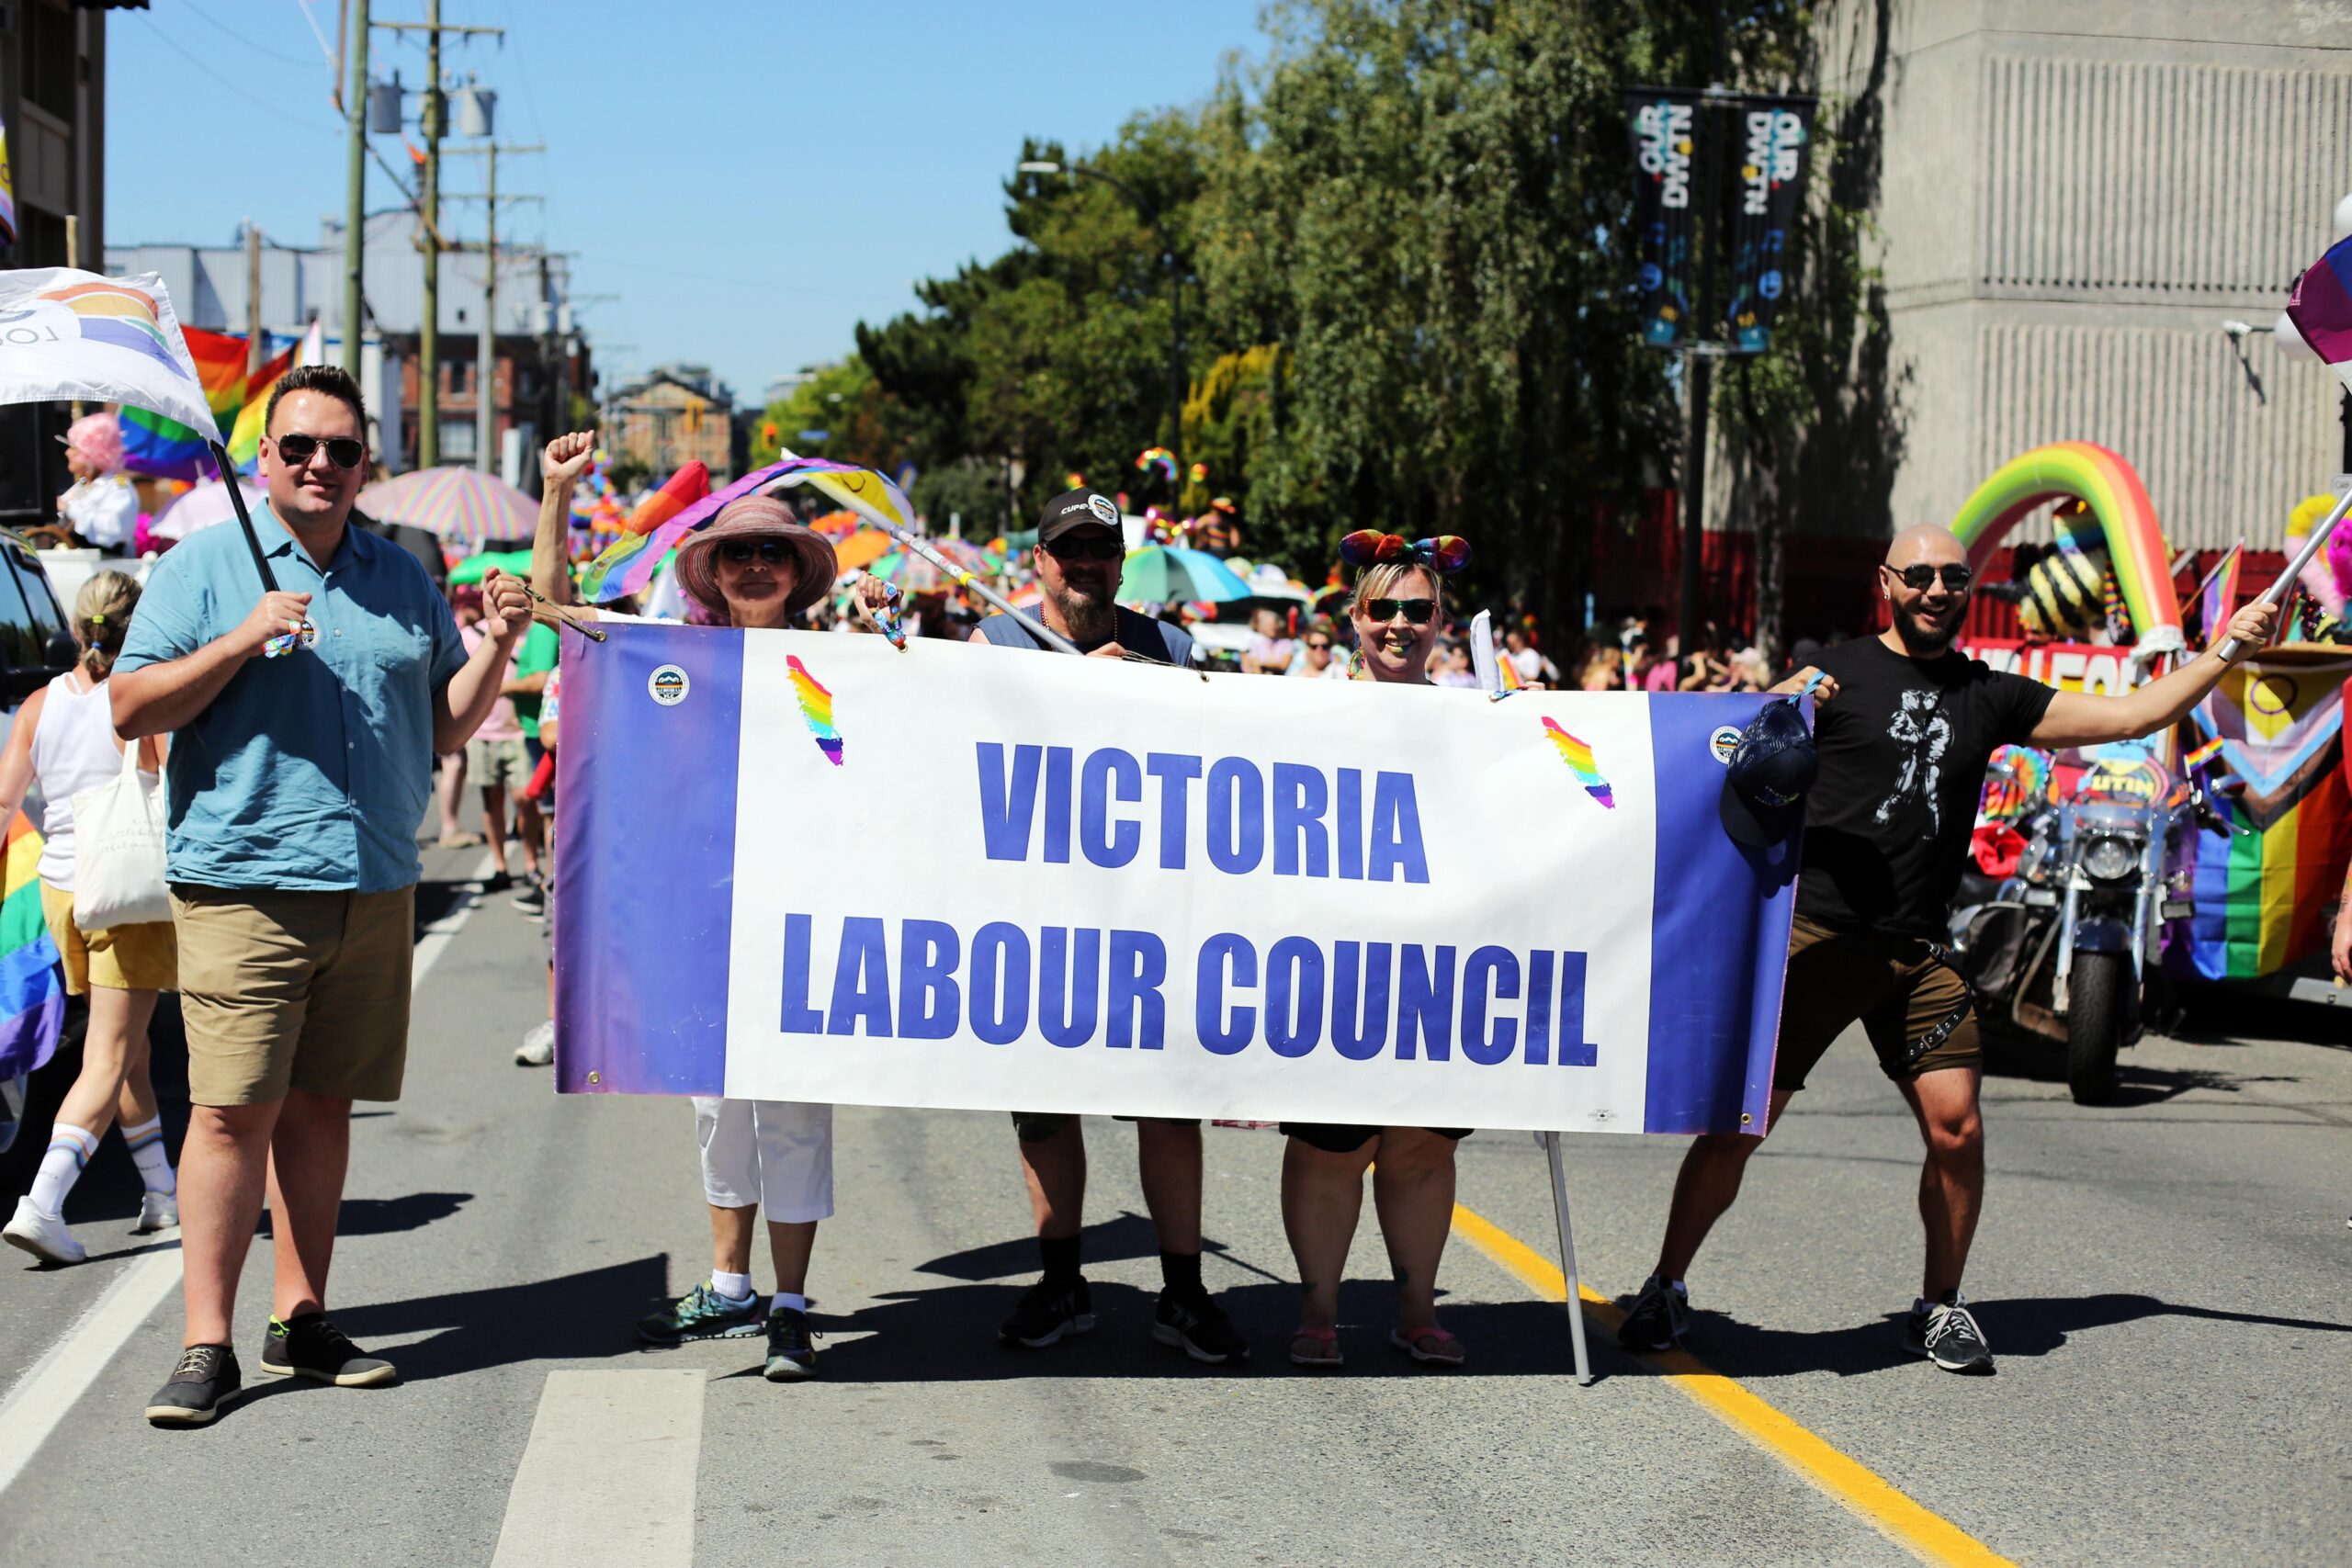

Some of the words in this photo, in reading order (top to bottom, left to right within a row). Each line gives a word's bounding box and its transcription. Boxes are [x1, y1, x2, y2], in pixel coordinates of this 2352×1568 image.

[1639, 105, 1665, 173] OUR
[1771, 111, 1802, 181] OUR
[977, 742, 1430, 884] VICTORIA
[780, 913, 1168, 1051] LABOUR
[1195, 932, 1599, 1066] COUNCIL
